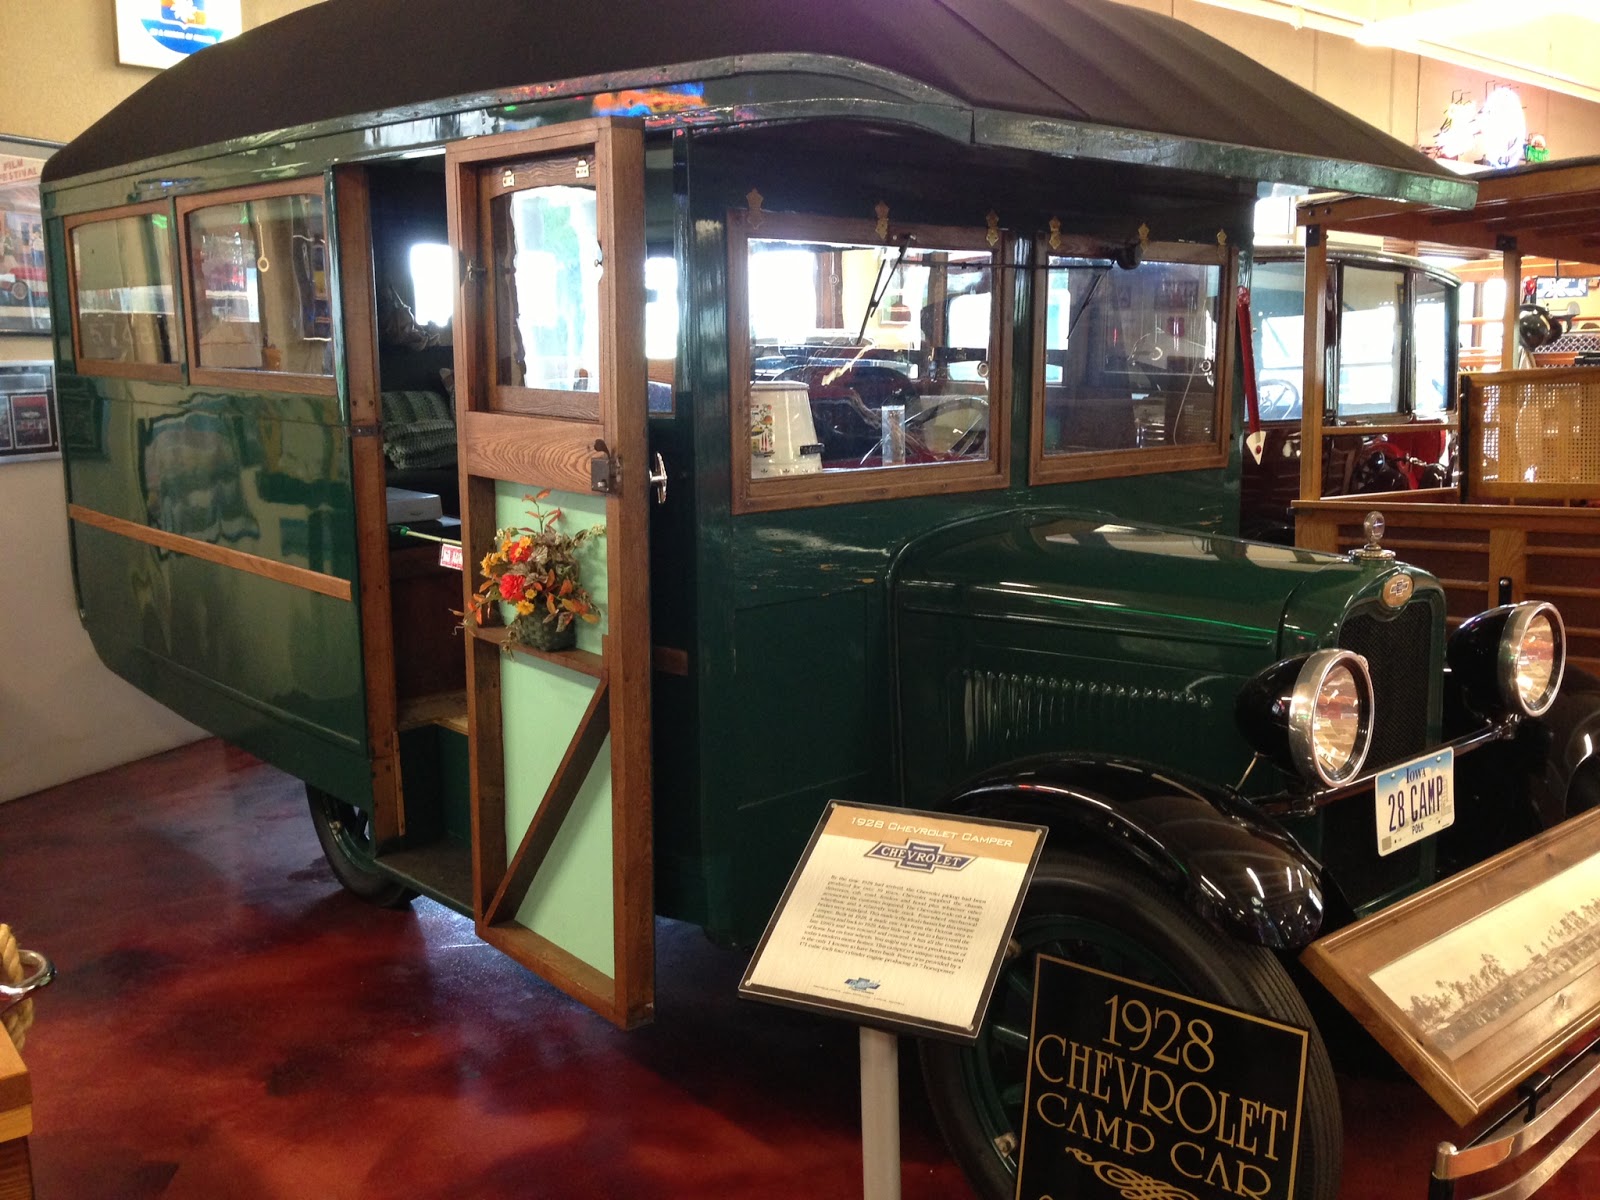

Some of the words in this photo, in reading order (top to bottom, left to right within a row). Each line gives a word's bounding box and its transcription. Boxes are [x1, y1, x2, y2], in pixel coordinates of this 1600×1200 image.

[851, 816, 885, 829] 1928
[888, 821, 959, 840] CHEVROLET
[961, 832, 1014, 848] CAMPER
[1388, 789, 1406, 832] 28
[1410, 775, 1443, 822] CAMP
[1412, 821, 1425, 835] POLK
[880, 845, 962, 867] CHEVROLET
[1102, 995, 1214, 1073] 1928
[1035, 1034, 1287, 1160] CHEVROLET
[1037, 1092, 1155, 1155] CAMP
[1170, 1141, 1272, 1200] CAR
